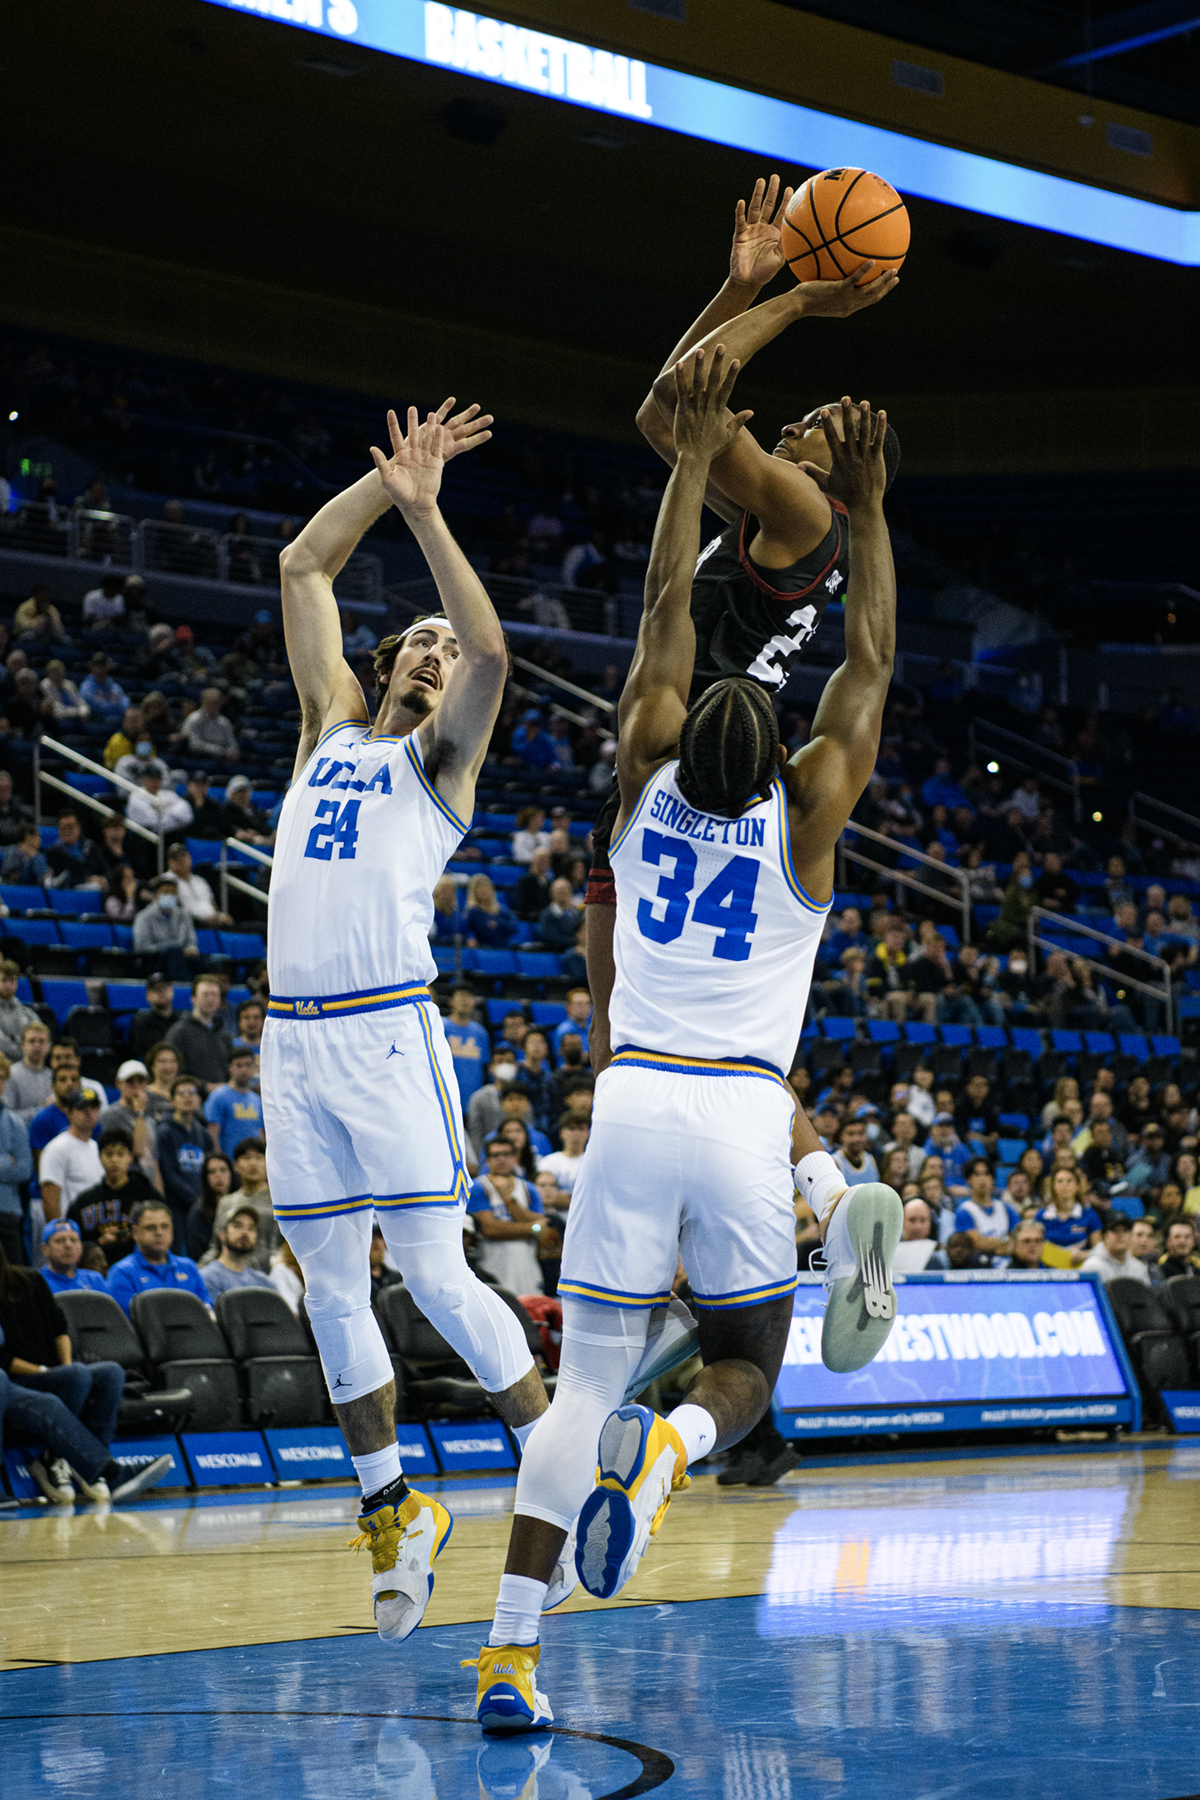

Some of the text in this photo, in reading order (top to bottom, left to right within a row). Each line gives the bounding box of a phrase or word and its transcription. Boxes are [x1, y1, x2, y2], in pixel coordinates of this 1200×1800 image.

[425, 1, 652, 118] BASKETBALL
[304, 799, 362, 861] 24
[650, 789, 766, 847] SINGLETON
[636, 827, 761, 962] 34
[295, 1000, 320, 1015] Ucla
[195, 1452, 250, 1468] WESCOM
[278, 1445, 333, 1461] WESCOM
[493, 1662, 516, 1676] Ucla
